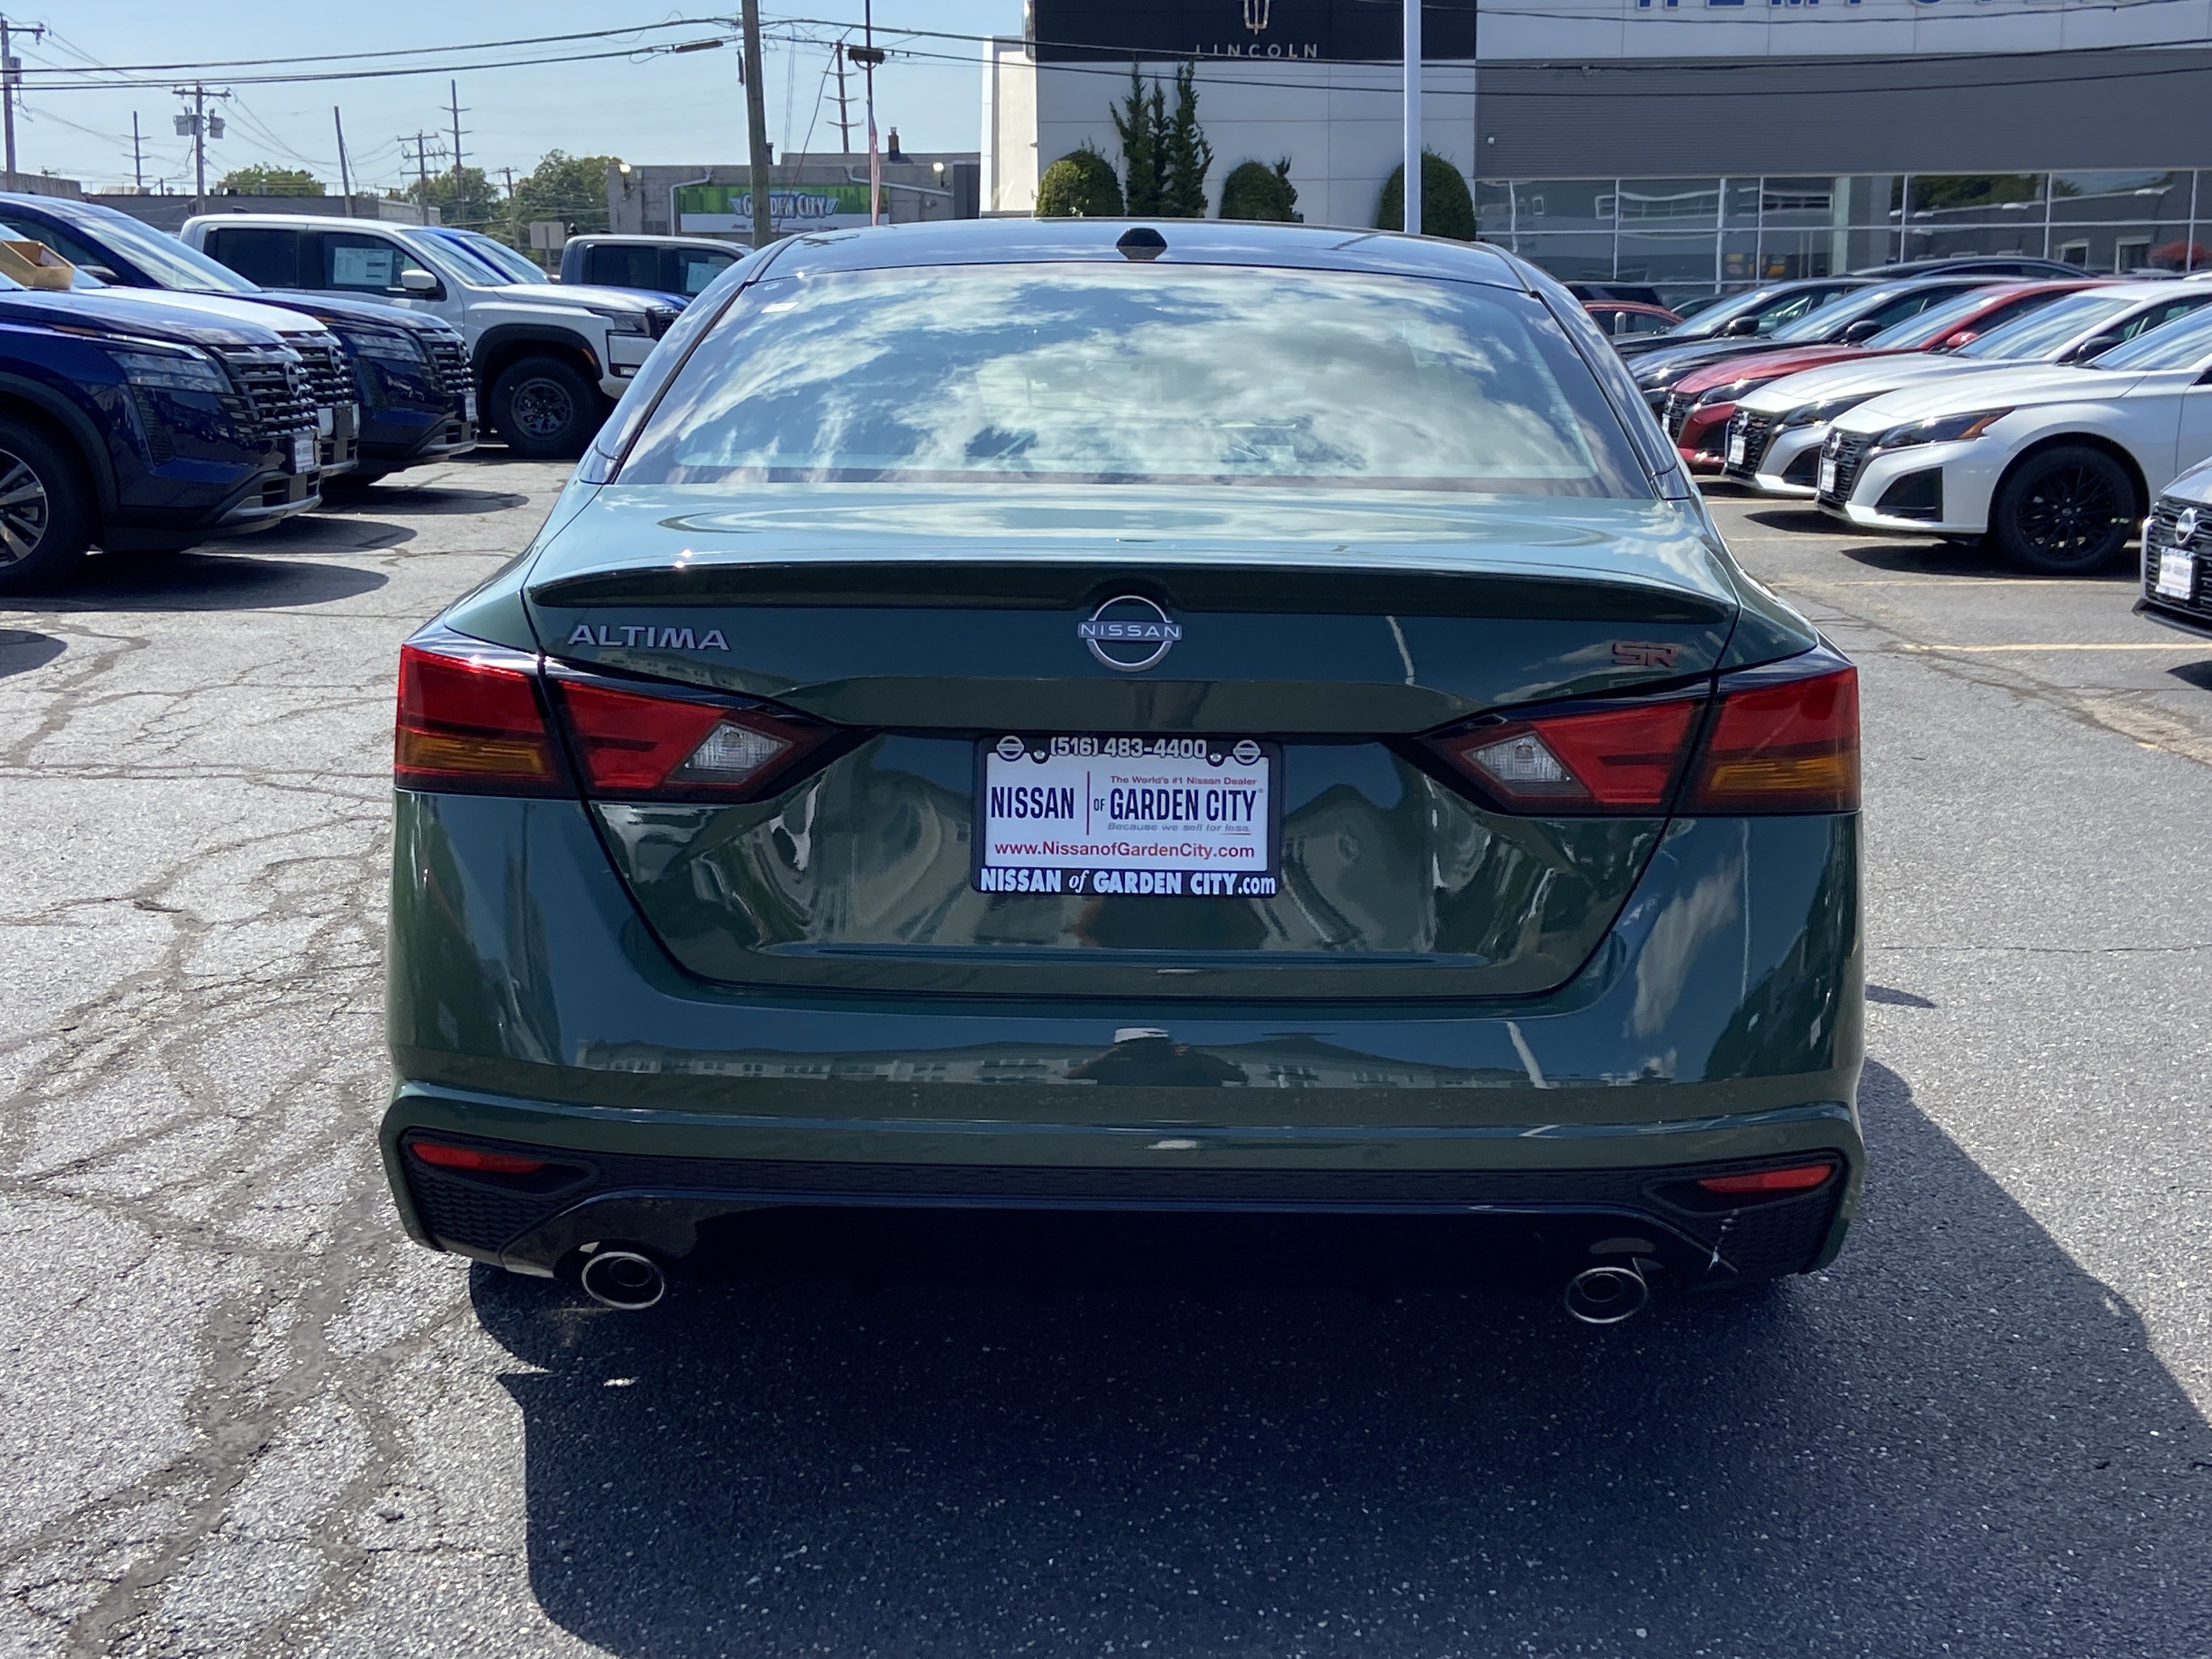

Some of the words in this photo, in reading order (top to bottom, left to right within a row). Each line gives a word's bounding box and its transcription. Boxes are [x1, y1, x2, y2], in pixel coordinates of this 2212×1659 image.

[1195, 44, 1317, 58] LINCOLN
[743, 195, 795, 218] GDEN
[797, 195, 825, 218] CITY
[568, 625, 730, 651] ALTIMA
[1081, 624, 1180, 638] NISSAN
[1612, 641, 1680, 668] SR
[1050, 737, 1098, 756] (516)
[1104, 738, 1207, 758] 483-4400
[1132, 776, 1169, 784] World's
[991, 787, 1074, 819] NISSAN
[1093, 798, 1105, 811] OF
[1110, 788, 1199, 821] GARDEN
[1206, 789, 1257, 821] CITY
[1108, 823, 1158, 831] Because
[995, 841, 1255, 860] www.NissanofGardenCity.com
[981, 868, 1061, 892] NISSAN
[1069, 870, 1090, 893] of
[1093, 871, 1182, 894] GARDEN
[1190, 873, 1276, 895] CITY.com
